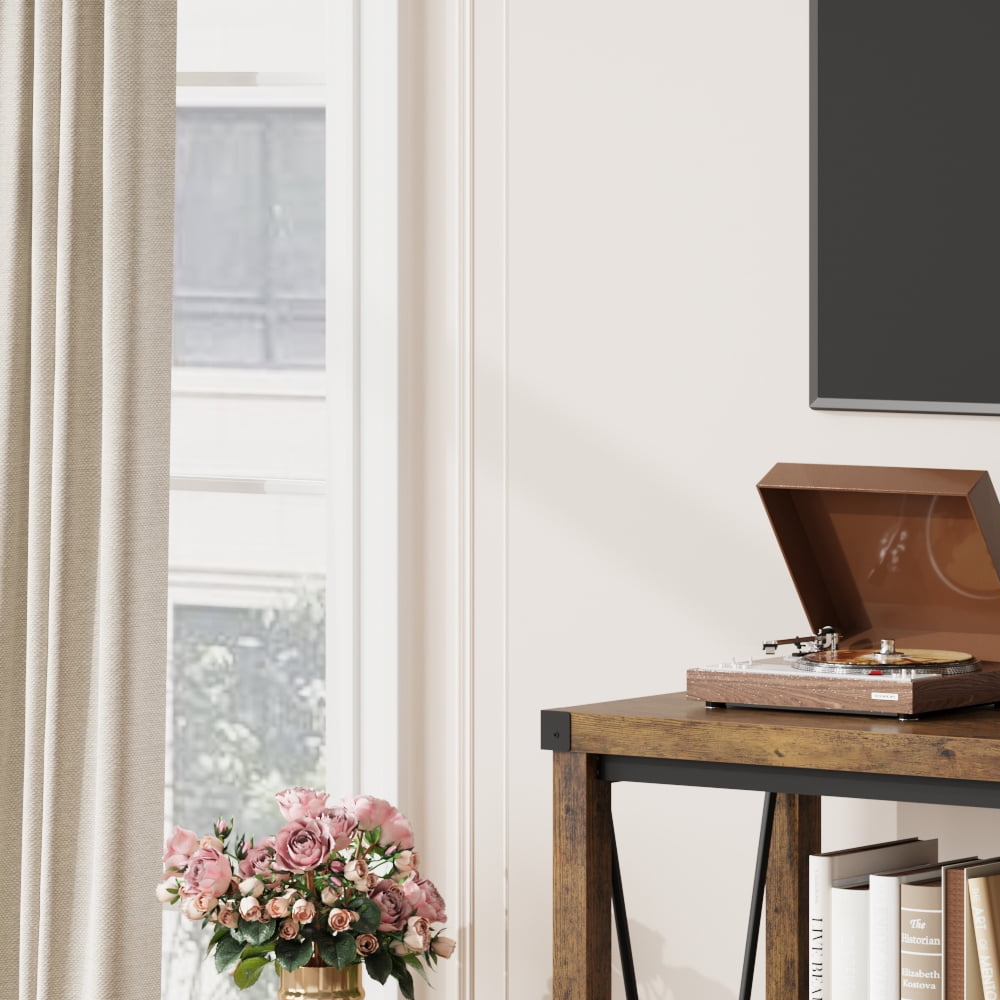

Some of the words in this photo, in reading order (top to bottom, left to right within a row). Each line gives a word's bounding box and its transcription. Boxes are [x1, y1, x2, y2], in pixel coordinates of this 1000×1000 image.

[910, 918, 926, 929] The
[973, 907, 987, 930] ART
[901, 932, 941, 945] Historian
[901, 968, 941, 979] Elizabeth
[902, 979, 937, 990] Kostova
